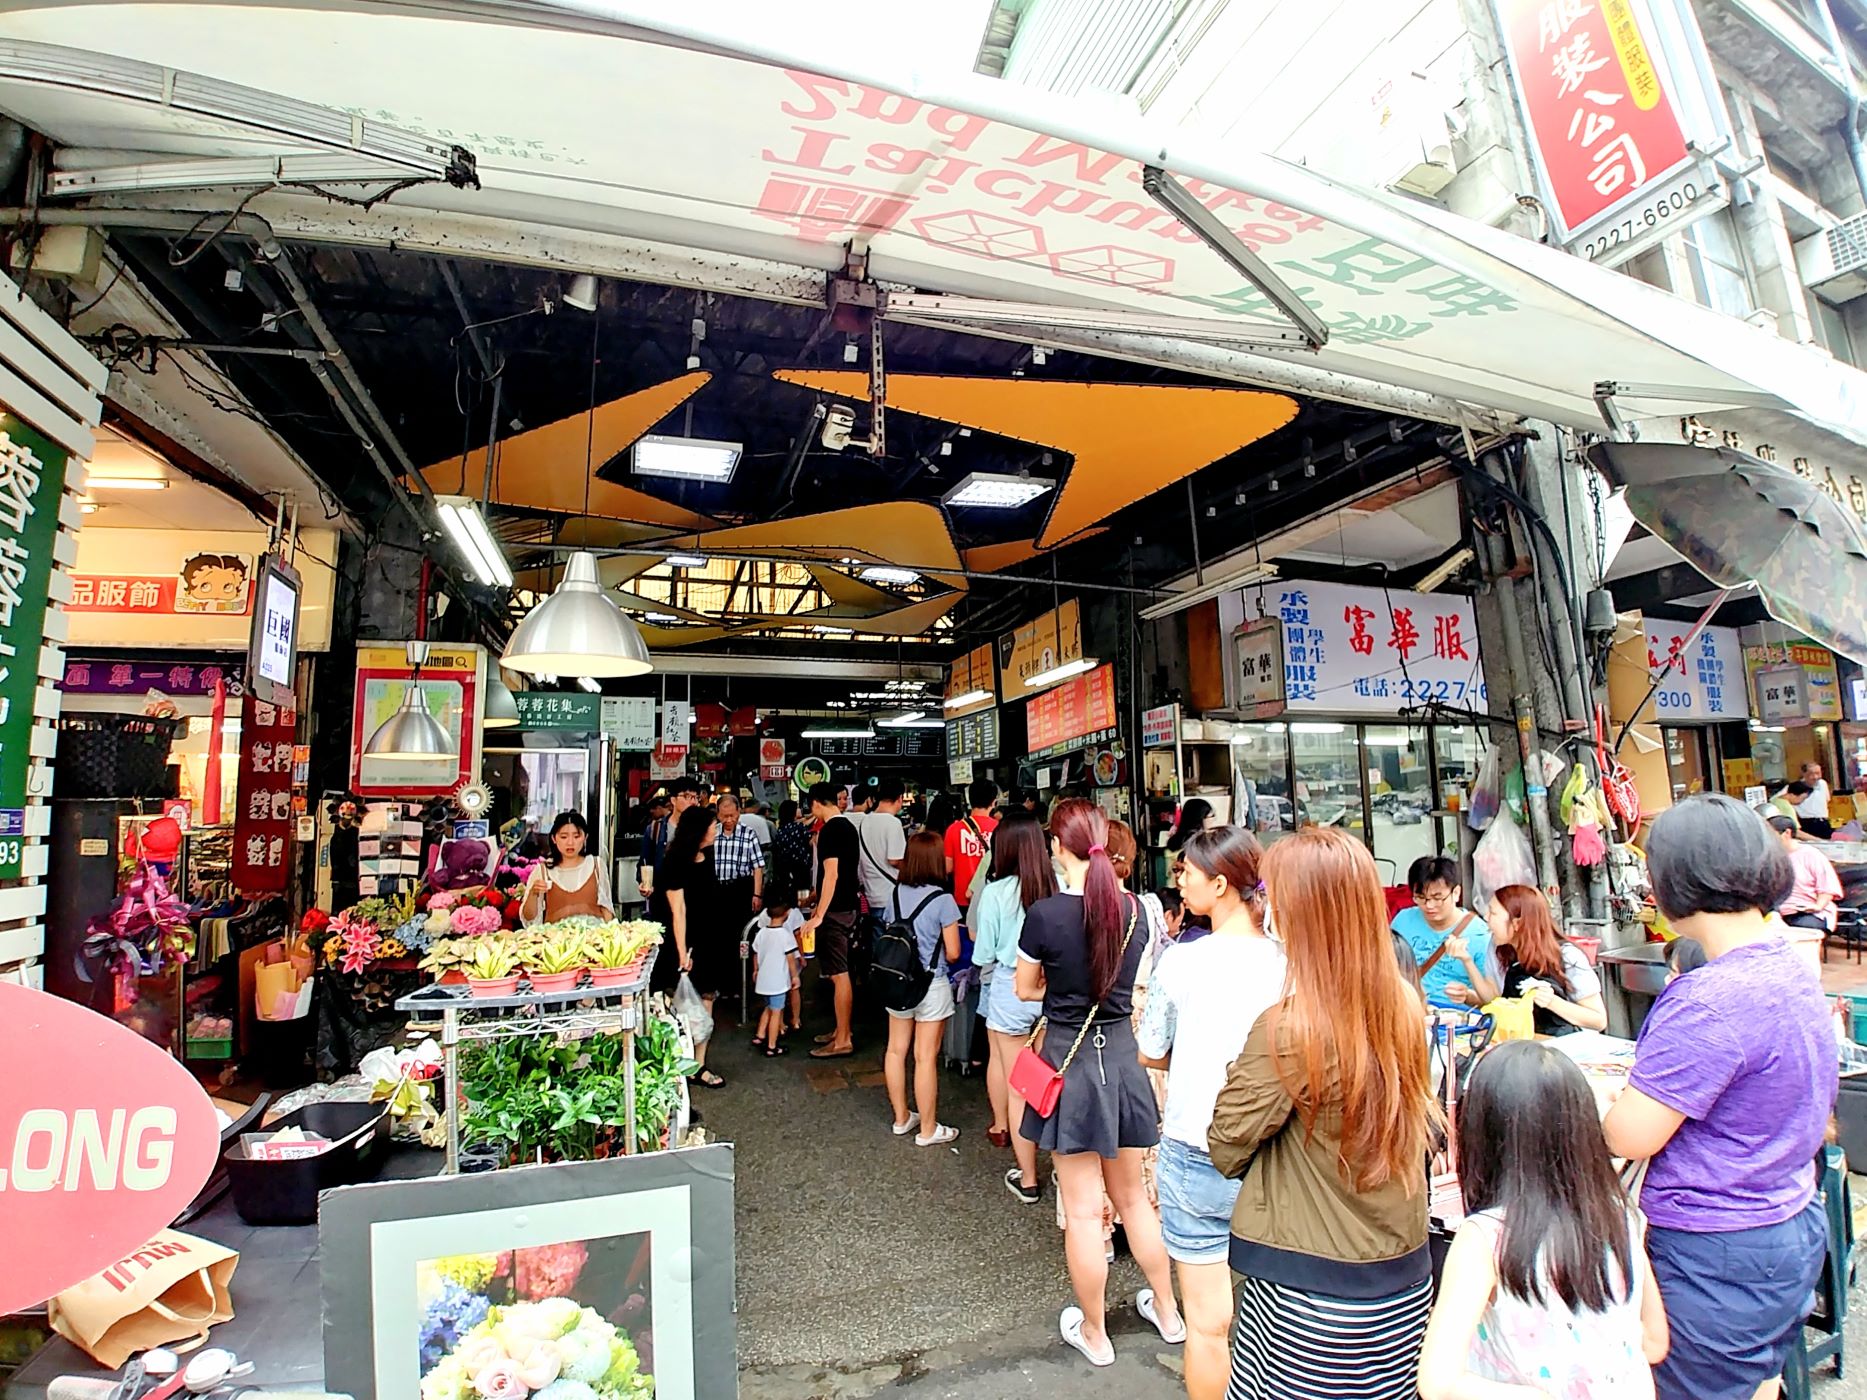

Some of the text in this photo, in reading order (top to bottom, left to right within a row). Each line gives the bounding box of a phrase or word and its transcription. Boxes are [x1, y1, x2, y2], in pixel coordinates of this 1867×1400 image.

[1585, 182, 1698, 261] 2227-6600
[1344, 604, 1469, 661] 富華服
[101, 1241, 193, 1293] MUJI
